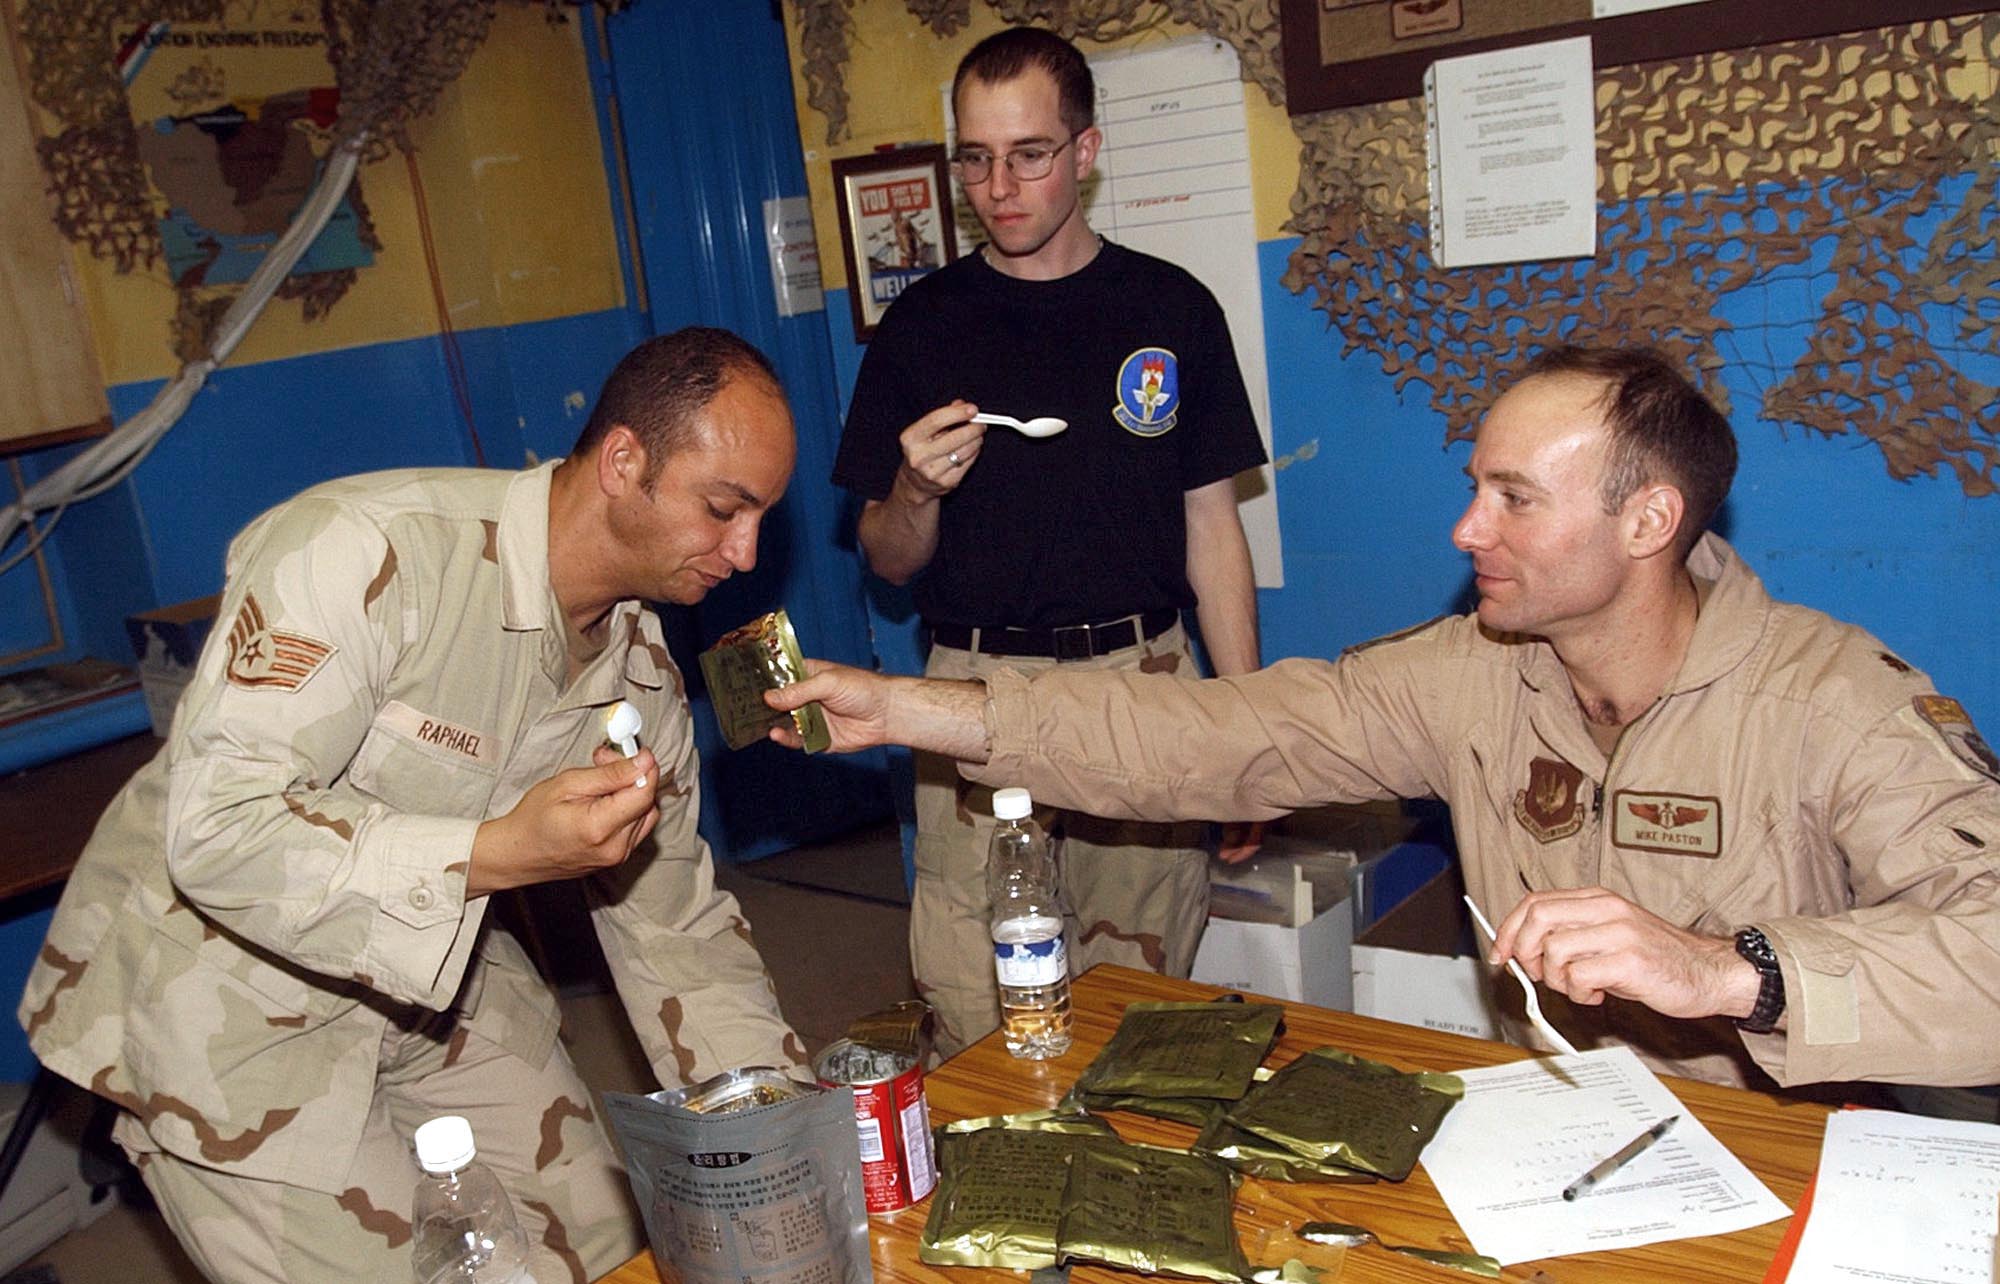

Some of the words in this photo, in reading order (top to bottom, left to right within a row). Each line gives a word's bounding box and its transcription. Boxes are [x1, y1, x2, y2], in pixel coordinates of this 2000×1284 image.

[861, 187, 889, 213] YOU
[416, 719, 481, 759] RAPHAEL
[1635, 829, 1658, 841] MIKE
[1661, 832, 1703, 846] PASTON
